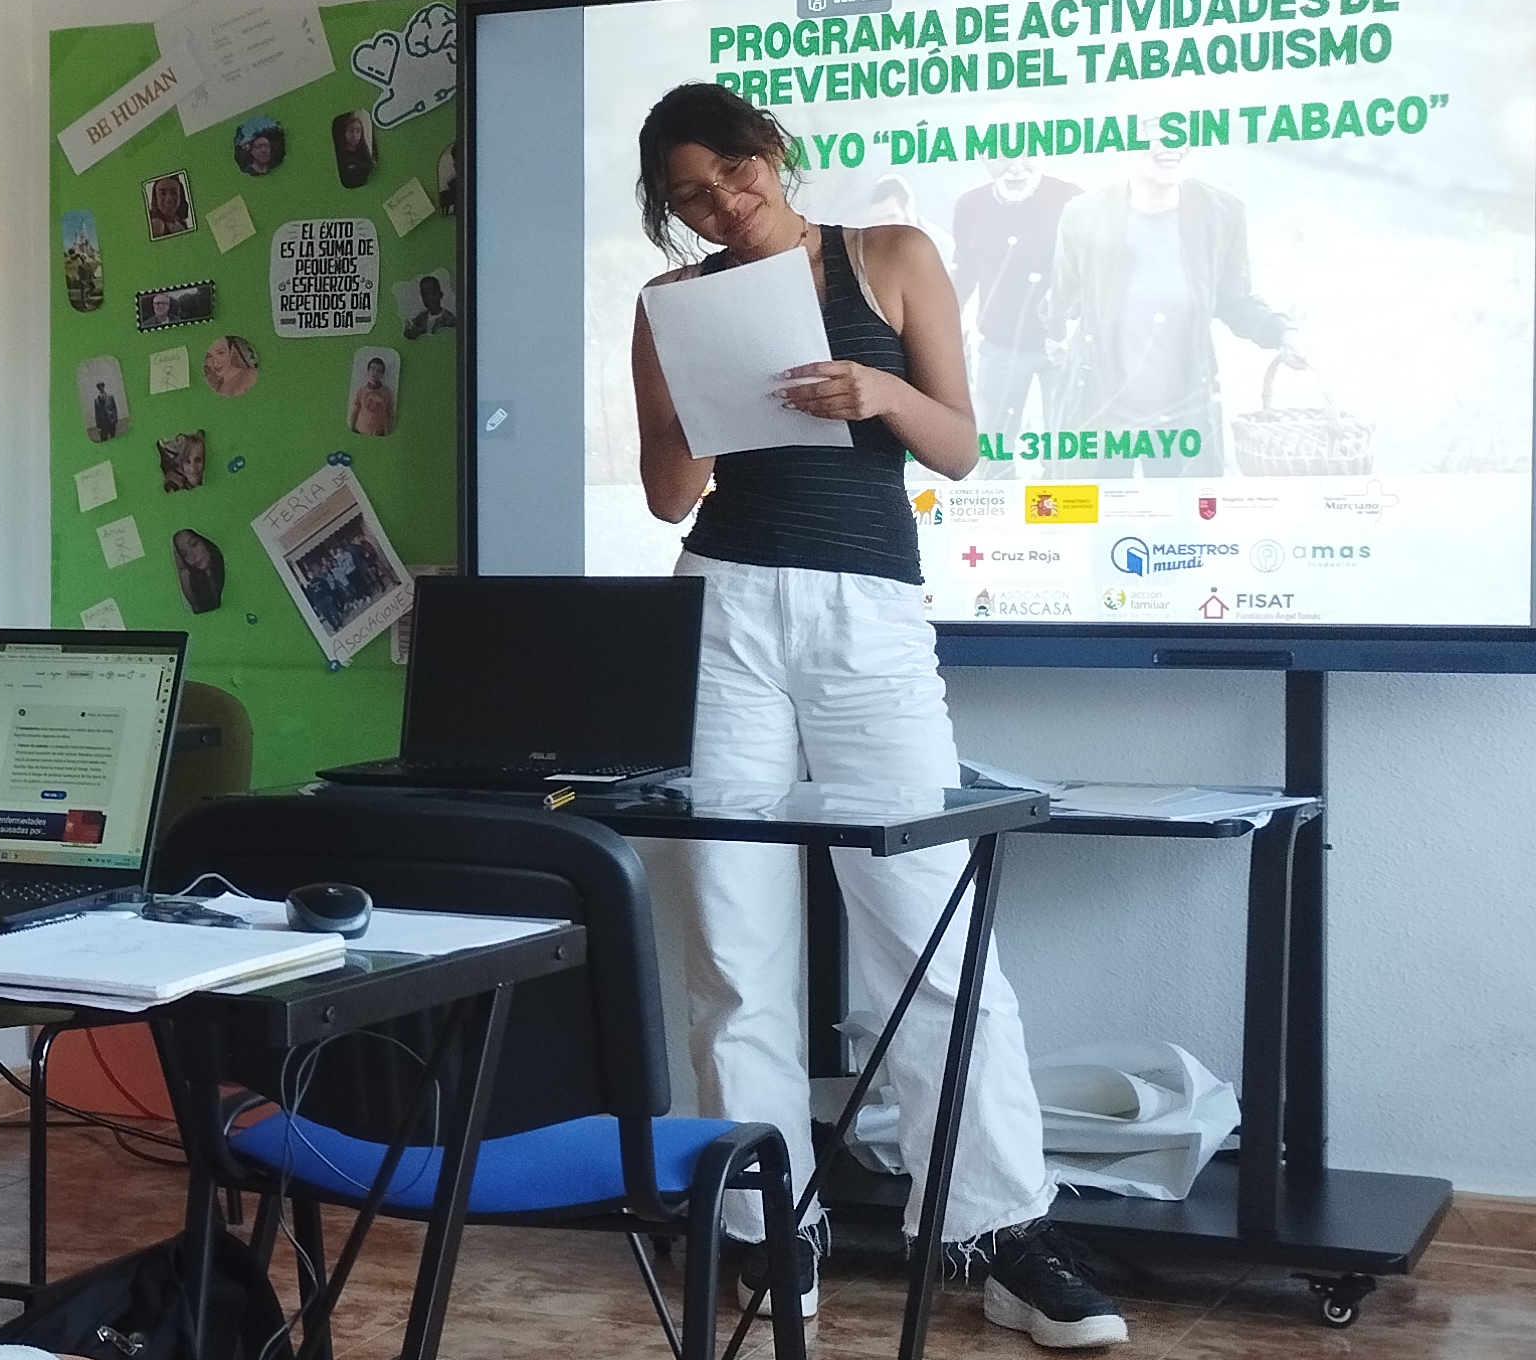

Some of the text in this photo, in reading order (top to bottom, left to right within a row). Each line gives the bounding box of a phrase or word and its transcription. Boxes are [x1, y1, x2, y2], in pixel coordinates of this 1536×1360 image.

[709, 10, 948, 64] PROGRAMA
[955, 3, 1010, 44] DE
[715, 22, 1392, 107] PREVENCIÓN DEL TABAQUISMO
[85, 66, 178, 146] BE HUMAN
[780, 131, 866, 172] AYO
[965, 113, 1151, 163] MUNDIAL
[1158, 107, 1231, 149] SIN
[301, 221, 354, 240] EL ÉXITO
[280, 238, 374, 259] ES LA SUMA DE
[292, 275, 361, 293] ESFUERZOS
[280, 292, 371, 312] REPETIDOS DÍA
[297, 310, 354, 329] TRAS DÍA
[977, 427, 1203, 462] AL 31 DE MAYO
[331, 471, 350, 489] DE
[949, 494, 1006, 506] servicios
[949, 505, 1006, 517] sociales
[991, 549, 1061, 564] Cruz Roja
[1152, 543, 1240, 556] MAESTROS
[1292, 544, 1372, 559] amas
[1153, 555, 1204, 573] mundi
[999, 602, 1073, 616] RASCASA
[1130, 600, 1170, 610] familiar
[1235, 593, 1295, 609] FISAT
